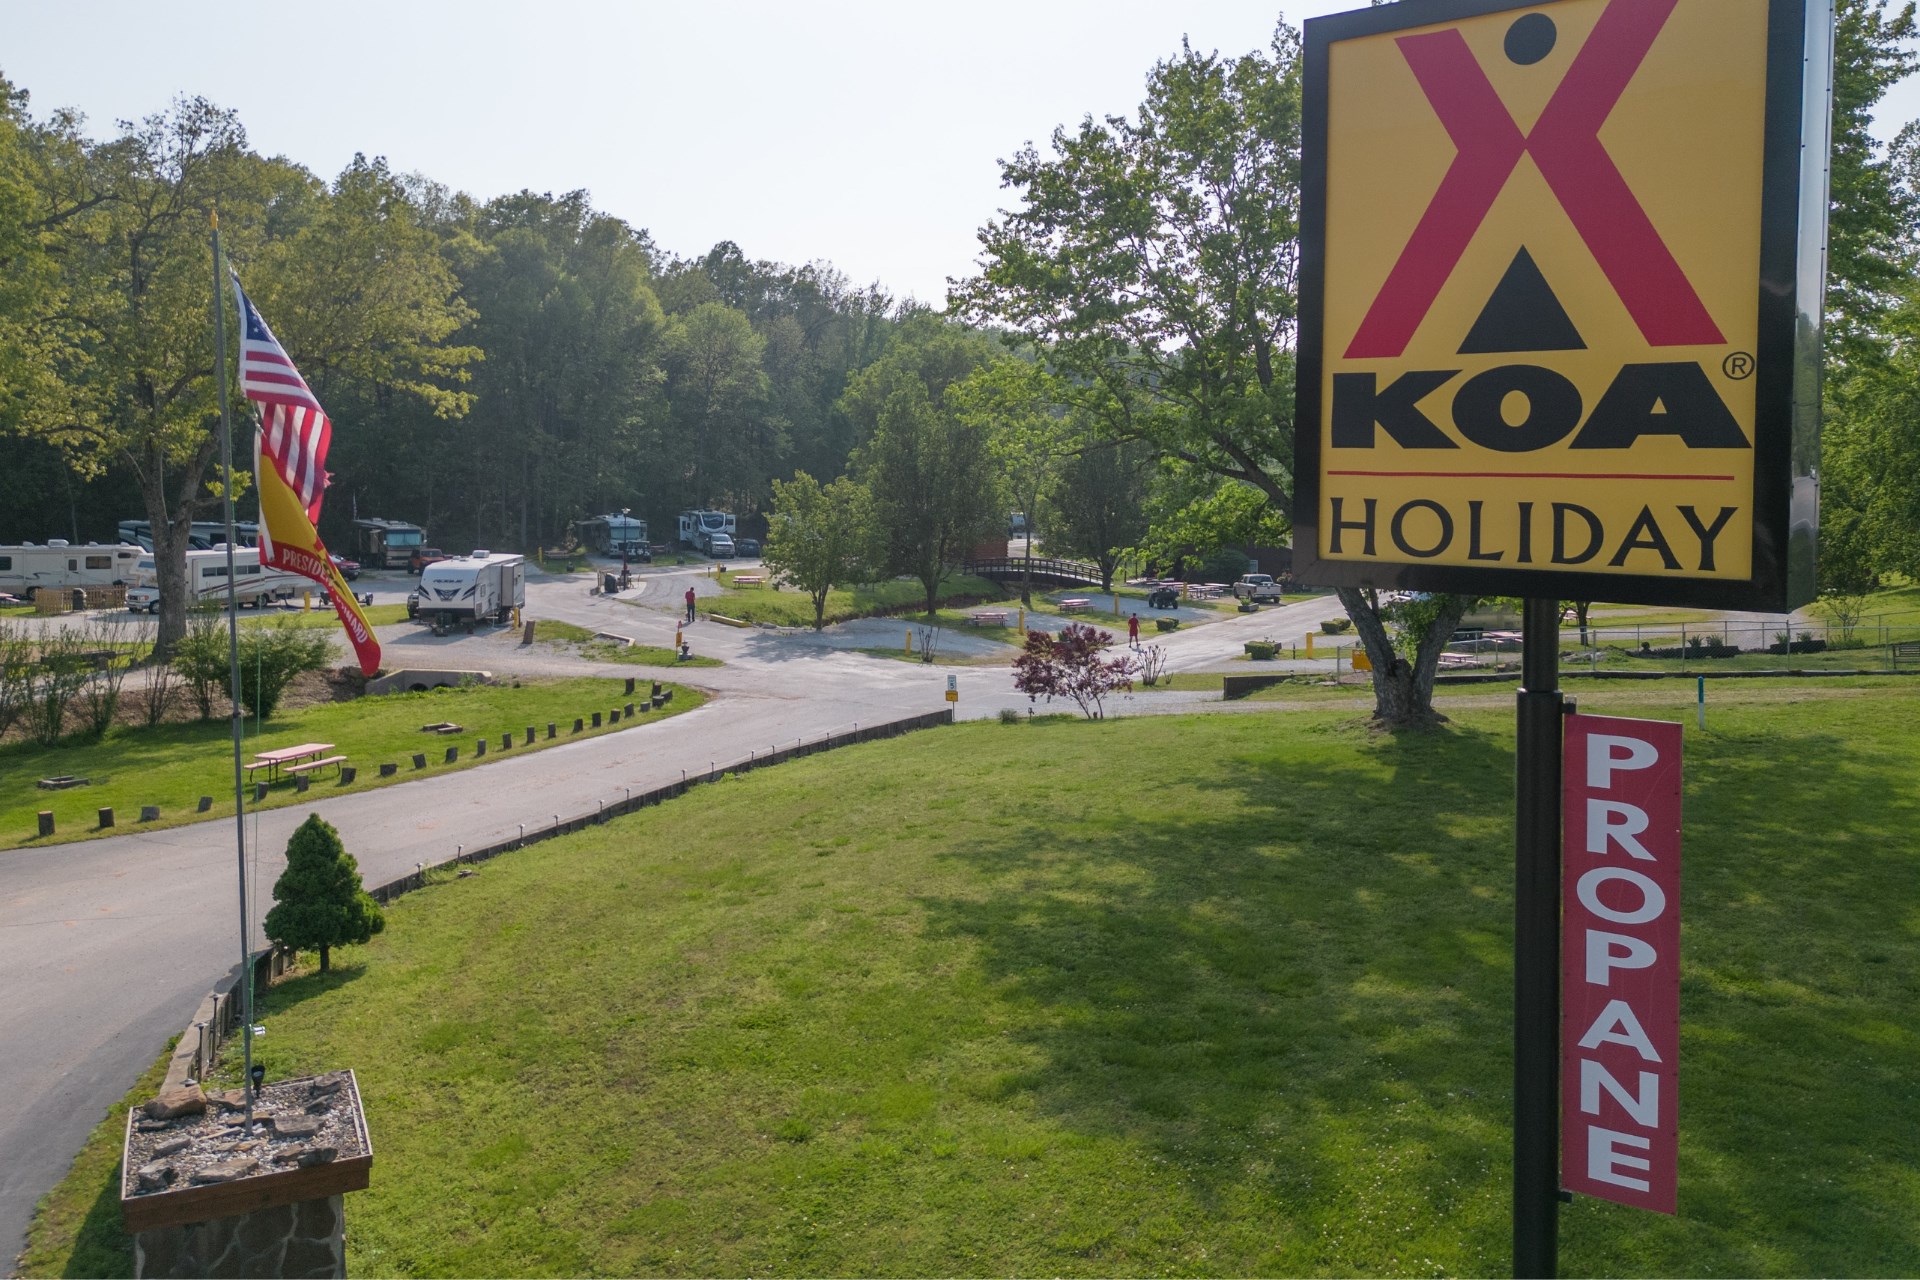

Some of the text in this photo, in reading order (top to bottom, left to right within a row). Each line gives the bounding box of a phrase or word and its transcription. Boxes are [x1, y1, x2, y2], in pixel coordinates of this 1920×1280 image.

[1331, 361, 1752, 452] KOA
[1329, 497, 1738, 571] HOLIDAY
[1577, 733, 1666, 1192] PROPANE
